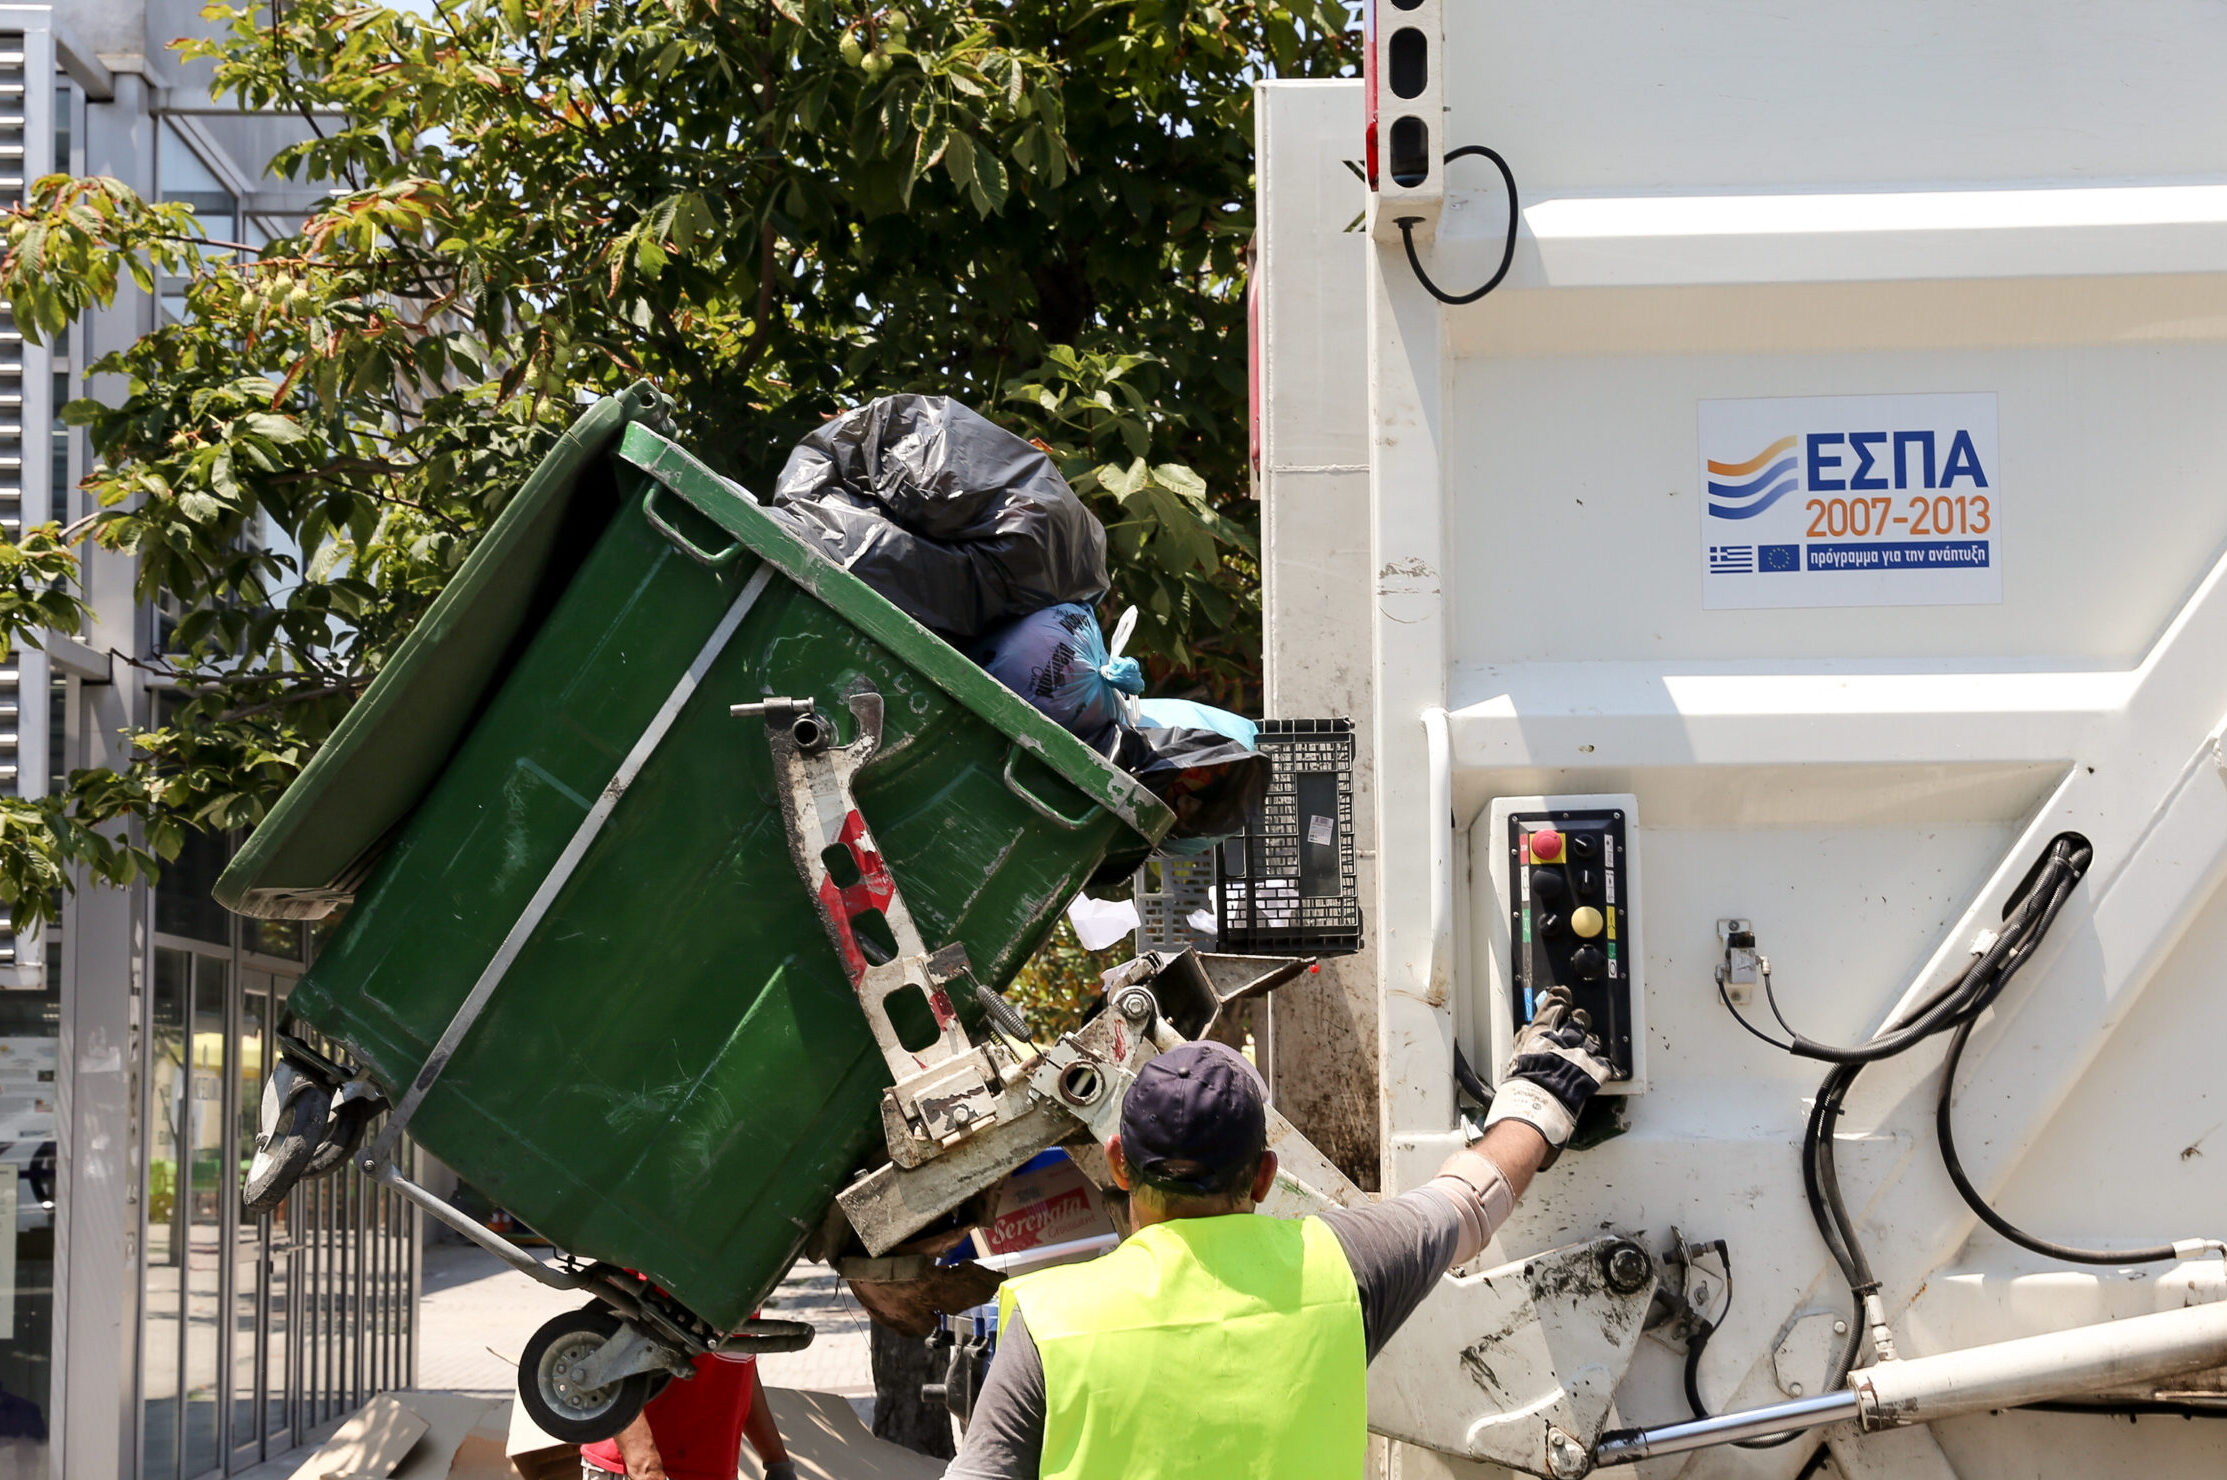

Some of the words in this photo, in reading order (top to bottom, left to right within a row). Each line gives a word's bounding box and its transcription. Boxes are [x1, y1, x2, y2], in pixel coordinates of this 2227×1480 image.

[1806, 429, 1989, 491] ΕΣΠΑ
[1805, 495, 1991, 538] 2007-2013
[1810, 548, 1879, 568] πρόγραμμα
[1881, 549, 1901, 567] για
[1904, 549, 1924, 563] την
[1928, 545, 1986, 564] ανάπτυξη
[991, 1196, 1081, 1244] Serenata
